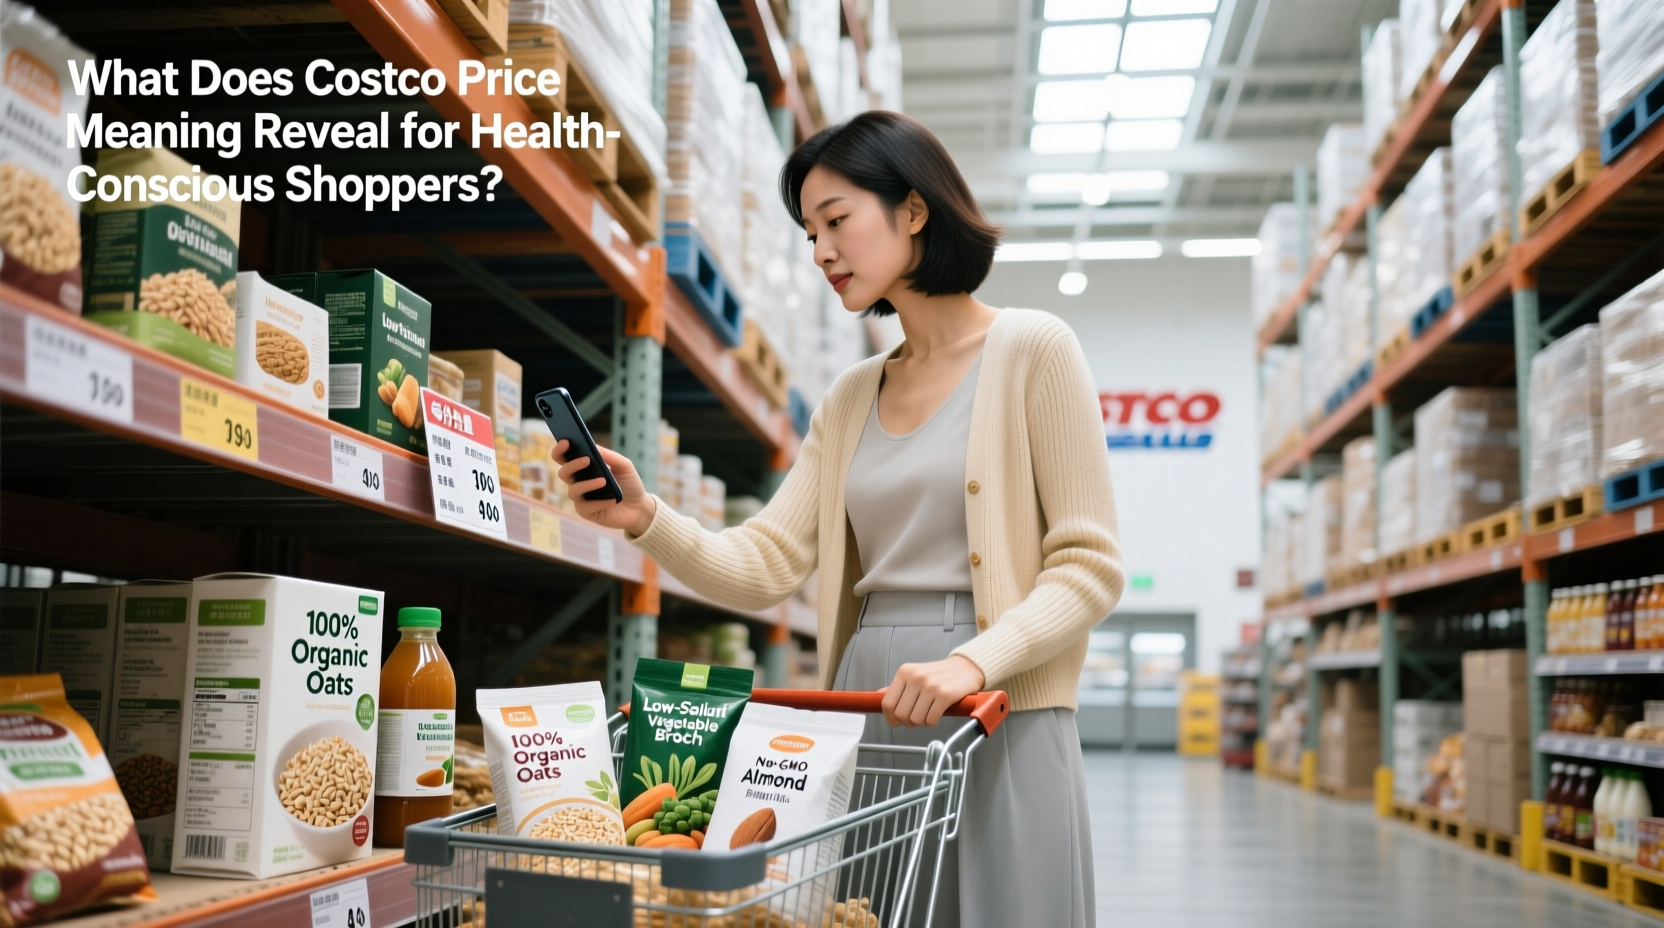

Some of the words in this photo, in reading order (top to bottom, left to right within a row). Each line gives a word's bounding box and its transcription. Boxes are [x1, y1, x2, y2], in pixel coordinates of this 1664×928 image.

[306, 609, 359, 640] 100%
[291, 638, 369, 672] Organic
[306, 670, 354, 696] Oats
[511, 731, 563, 749] 100%
[513, 744, 587, 767] Organic
[517, 767, 562, 783] Oats
[740, 768, 808, 791] Almond
